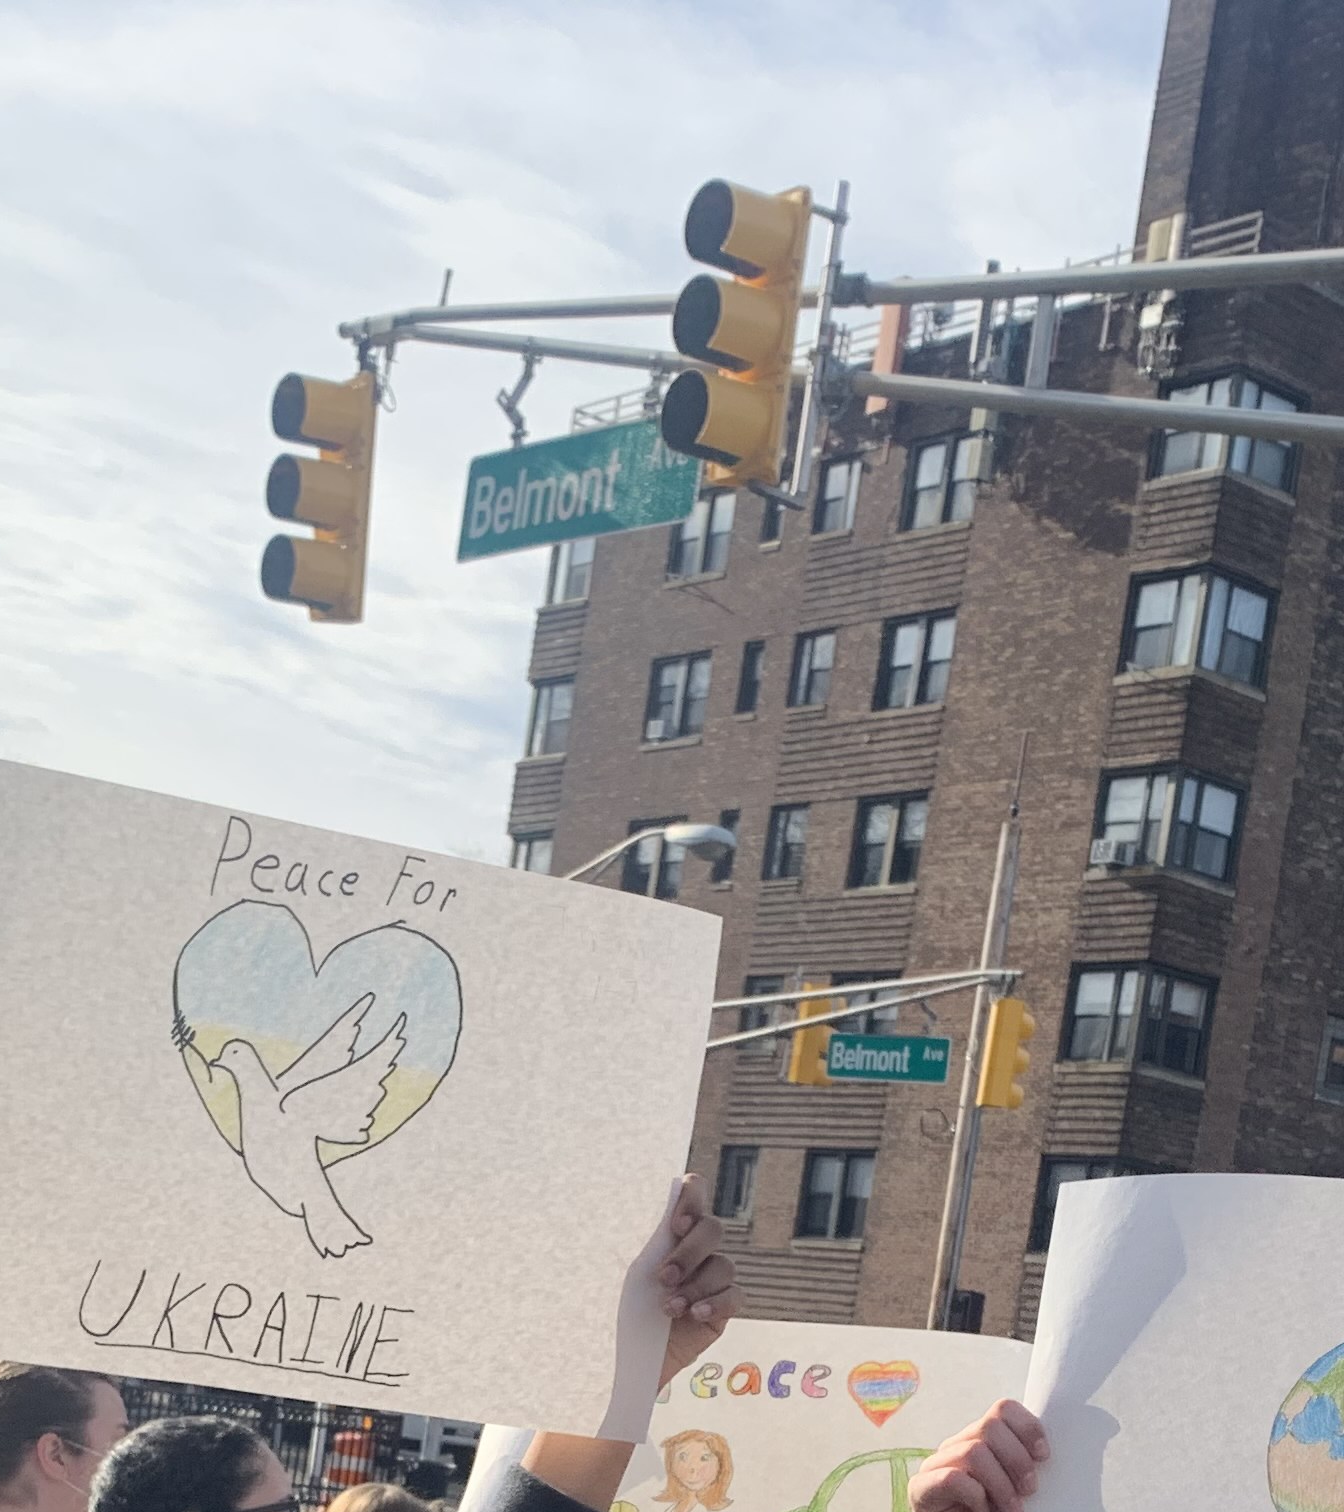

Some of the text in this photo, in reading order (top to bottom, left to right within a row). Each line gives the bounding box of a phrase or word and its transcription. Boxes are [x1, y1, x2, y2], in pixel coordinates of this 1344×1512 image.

[469, 453, 622, 539] Belmont
[210, 815, 457, 912] Peace For
[830, 1041, 944, 1073] Belmont Ave
[79, 1259, 415, 1382] UKRAINE
[656, 1359, 833, 1404] eace
